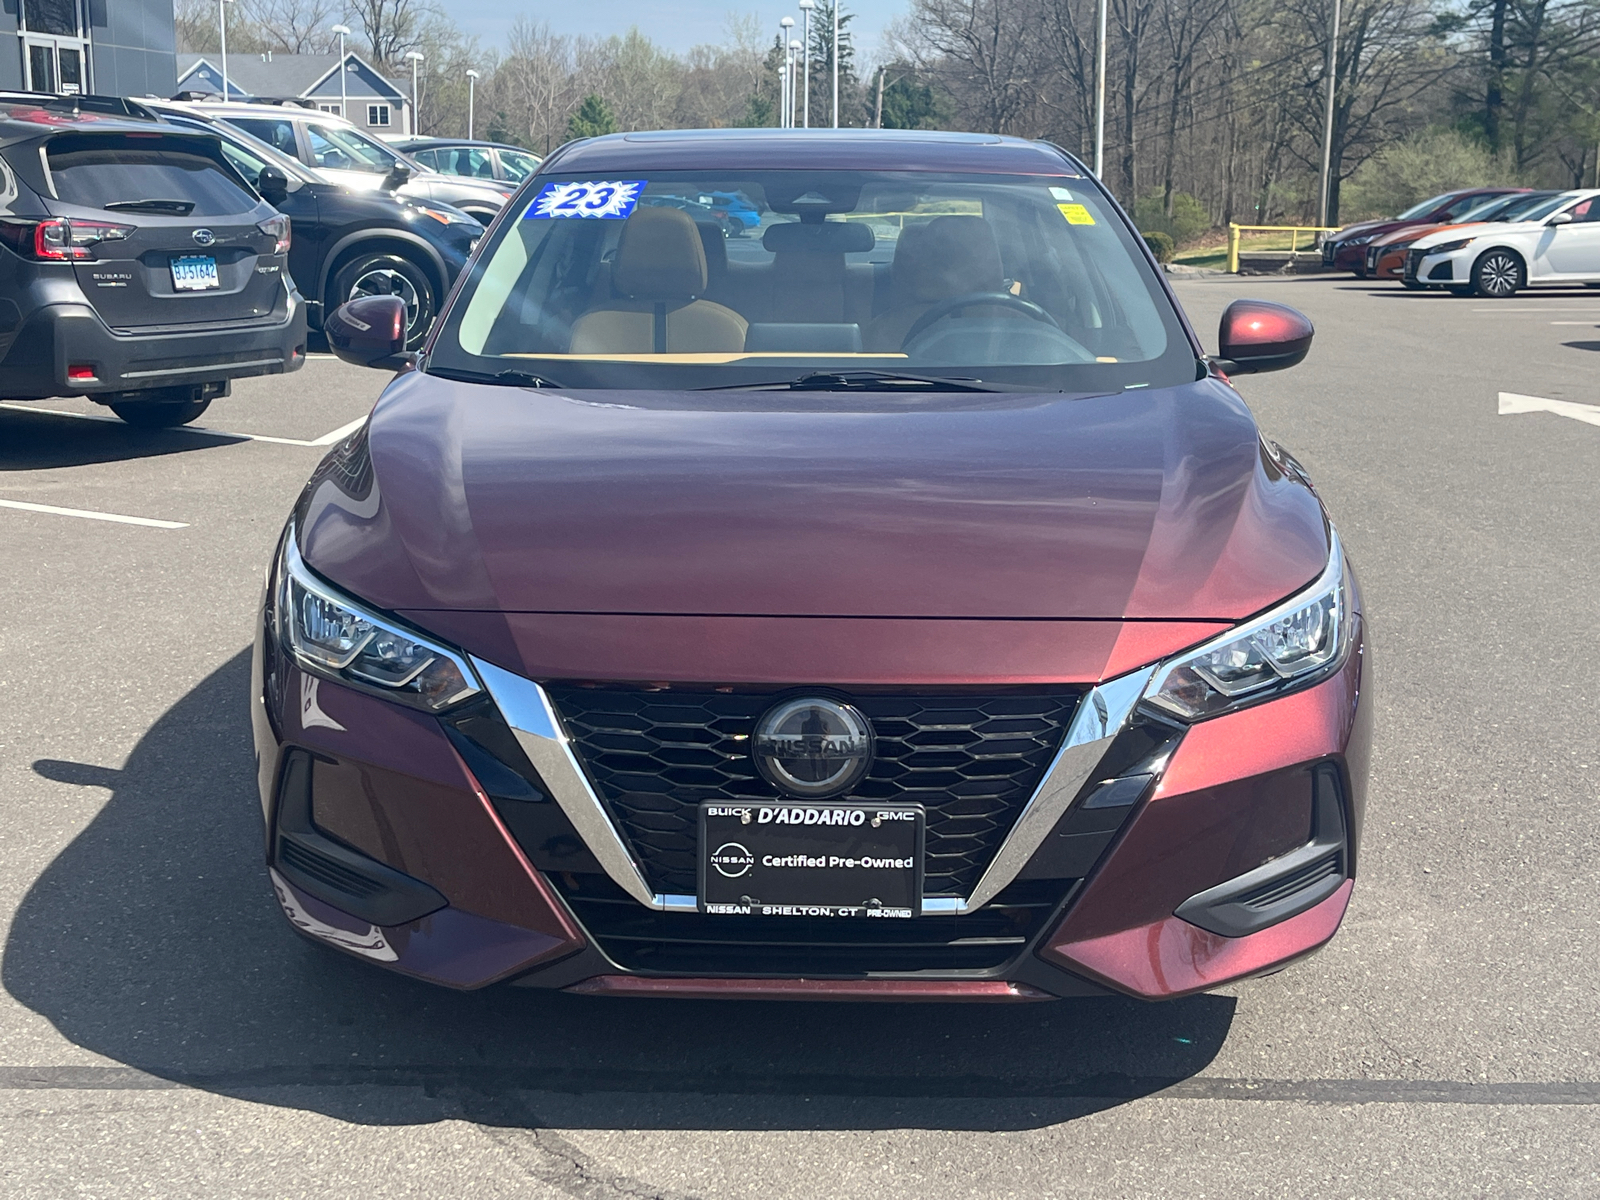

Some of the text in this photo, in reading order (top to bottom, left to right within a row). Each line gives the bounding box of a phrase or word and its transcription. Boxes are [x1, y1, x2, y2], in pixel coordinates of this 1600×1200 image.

[554, 187, 615, 210] 23
[707, 807, 915, 826] BUICK D'ADDARIO GMC
[710, 855, 754, 864] NISSAN
[762, 854, 913, 869] Certified Pre-Owned
[706, 905, 912, 918] NISSAN SHELTON, CT PRE-OWNED
